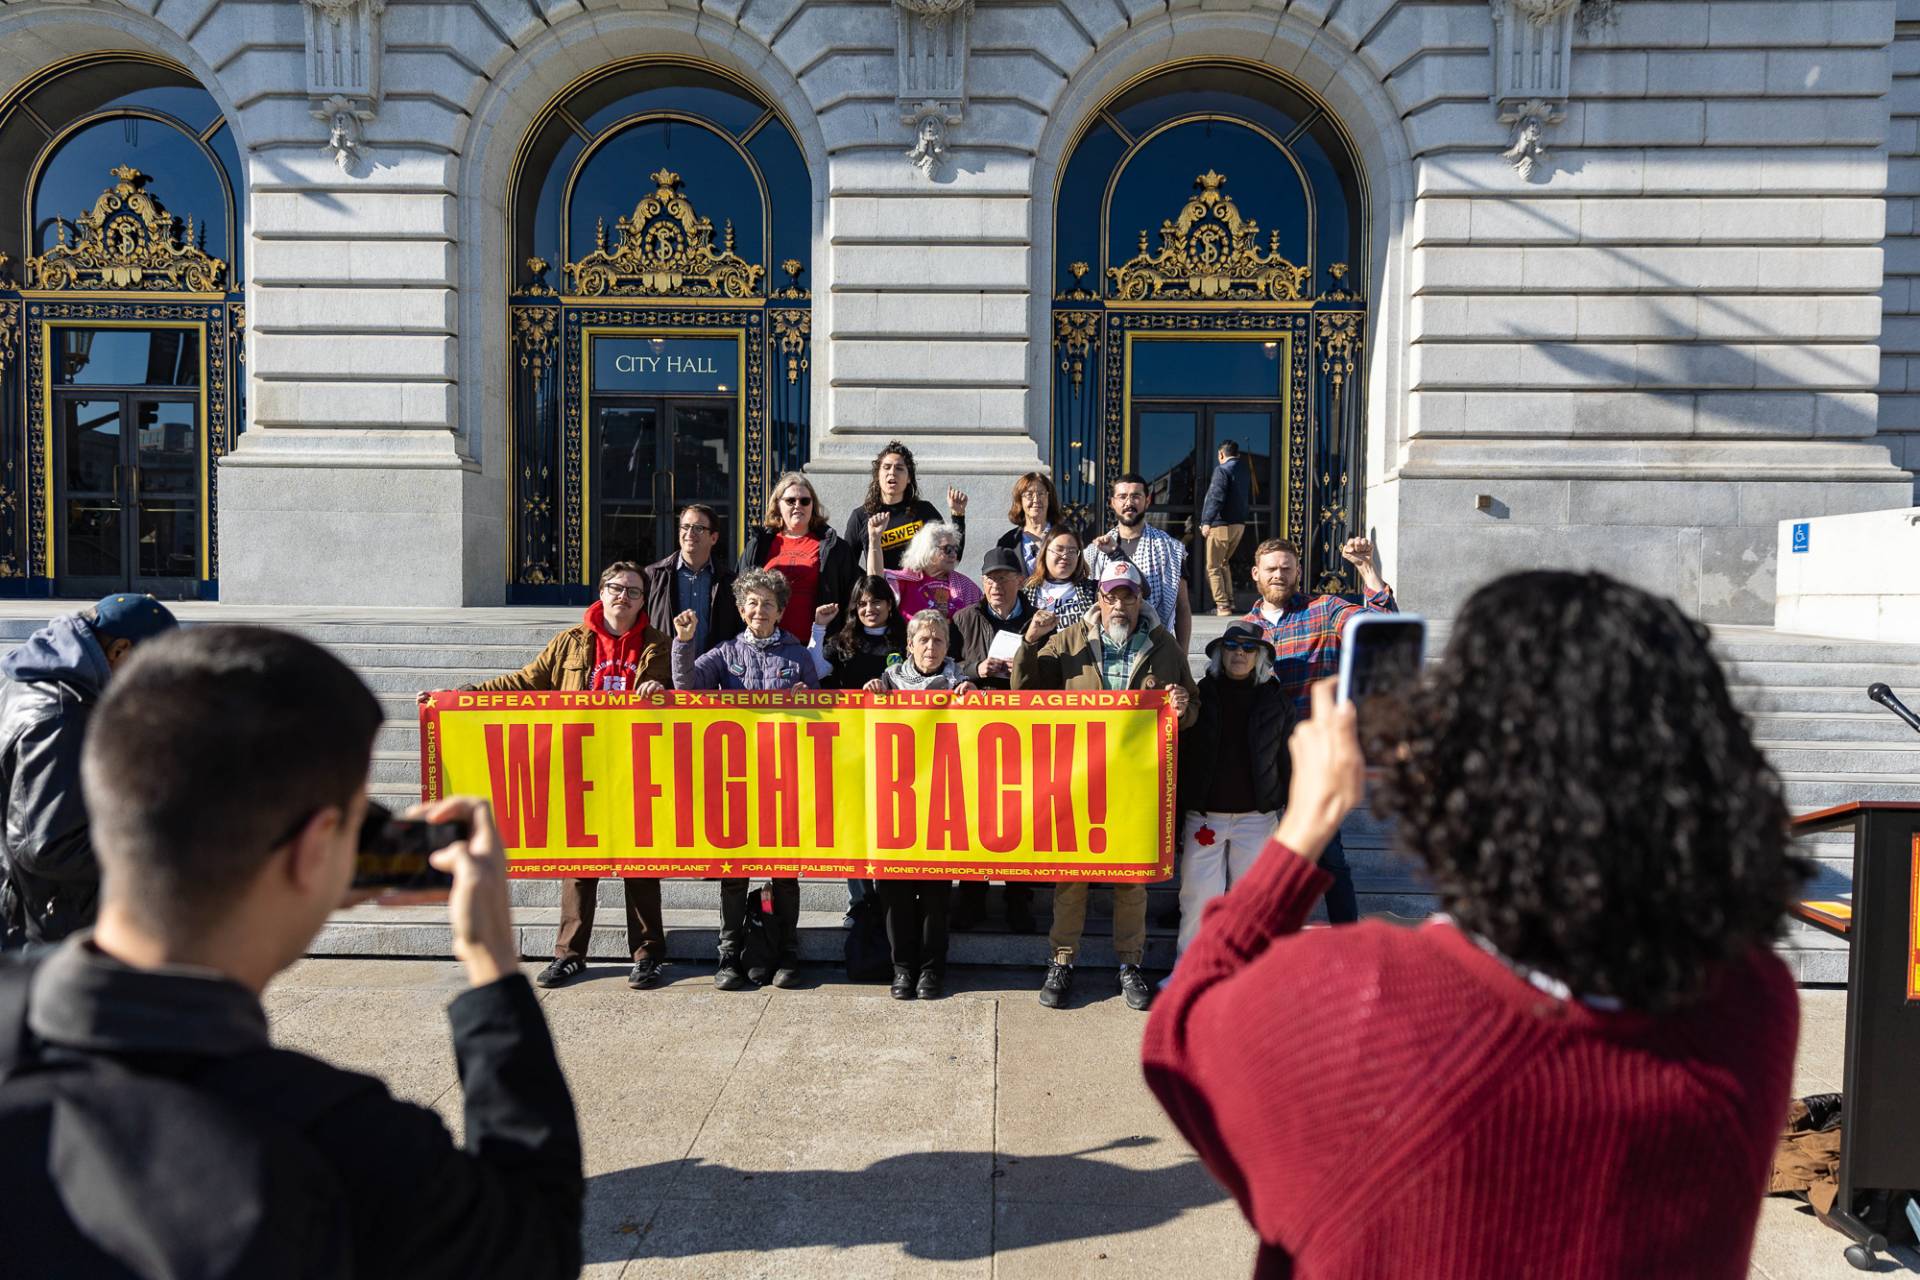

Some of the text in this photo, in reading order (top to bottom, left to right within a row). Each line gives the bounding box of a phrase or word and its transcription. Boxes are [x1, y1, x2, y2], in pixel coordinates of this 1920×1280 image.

[615, 354, 718, 373] CITY HALL
[880, 524, 921, 544] NSWER
[458, 693, 1140, 707] DEFEAT TRUMPS EXTREME-RIGHT BILLIONAIRE AGENDA!
[427, 721, 437, 764] RIGHTS
[484, 721, 1107, 854] WE FIGHT BACK!
[1165, 715, 1174, 854] FOR IMMIGRANT RIGHTS
[506, 865, 541, 873] UTURE
[541, 865, 557, 873] OF
[582, 864, 622, 872] PEOPLE
[623, 864, 646, 872] AND
[646, 864, 670, 872] OUR
[671, 864, 711, 872] PLANET
[741, 864, 856, 873] FOR A FREE PALESTINE
[883, 866, 921, 874] MONEY
[944, 867, 995, 875] PEOPLE'S
[995, 868, 1033, 877] NEEDS,
[1033, 869, 1057, 877] NOT
[1058, 869, 1080, 877] THE
[1080, 869, 1107, 877] WAR
[1107, 869, 1157, 877] MACHINE
